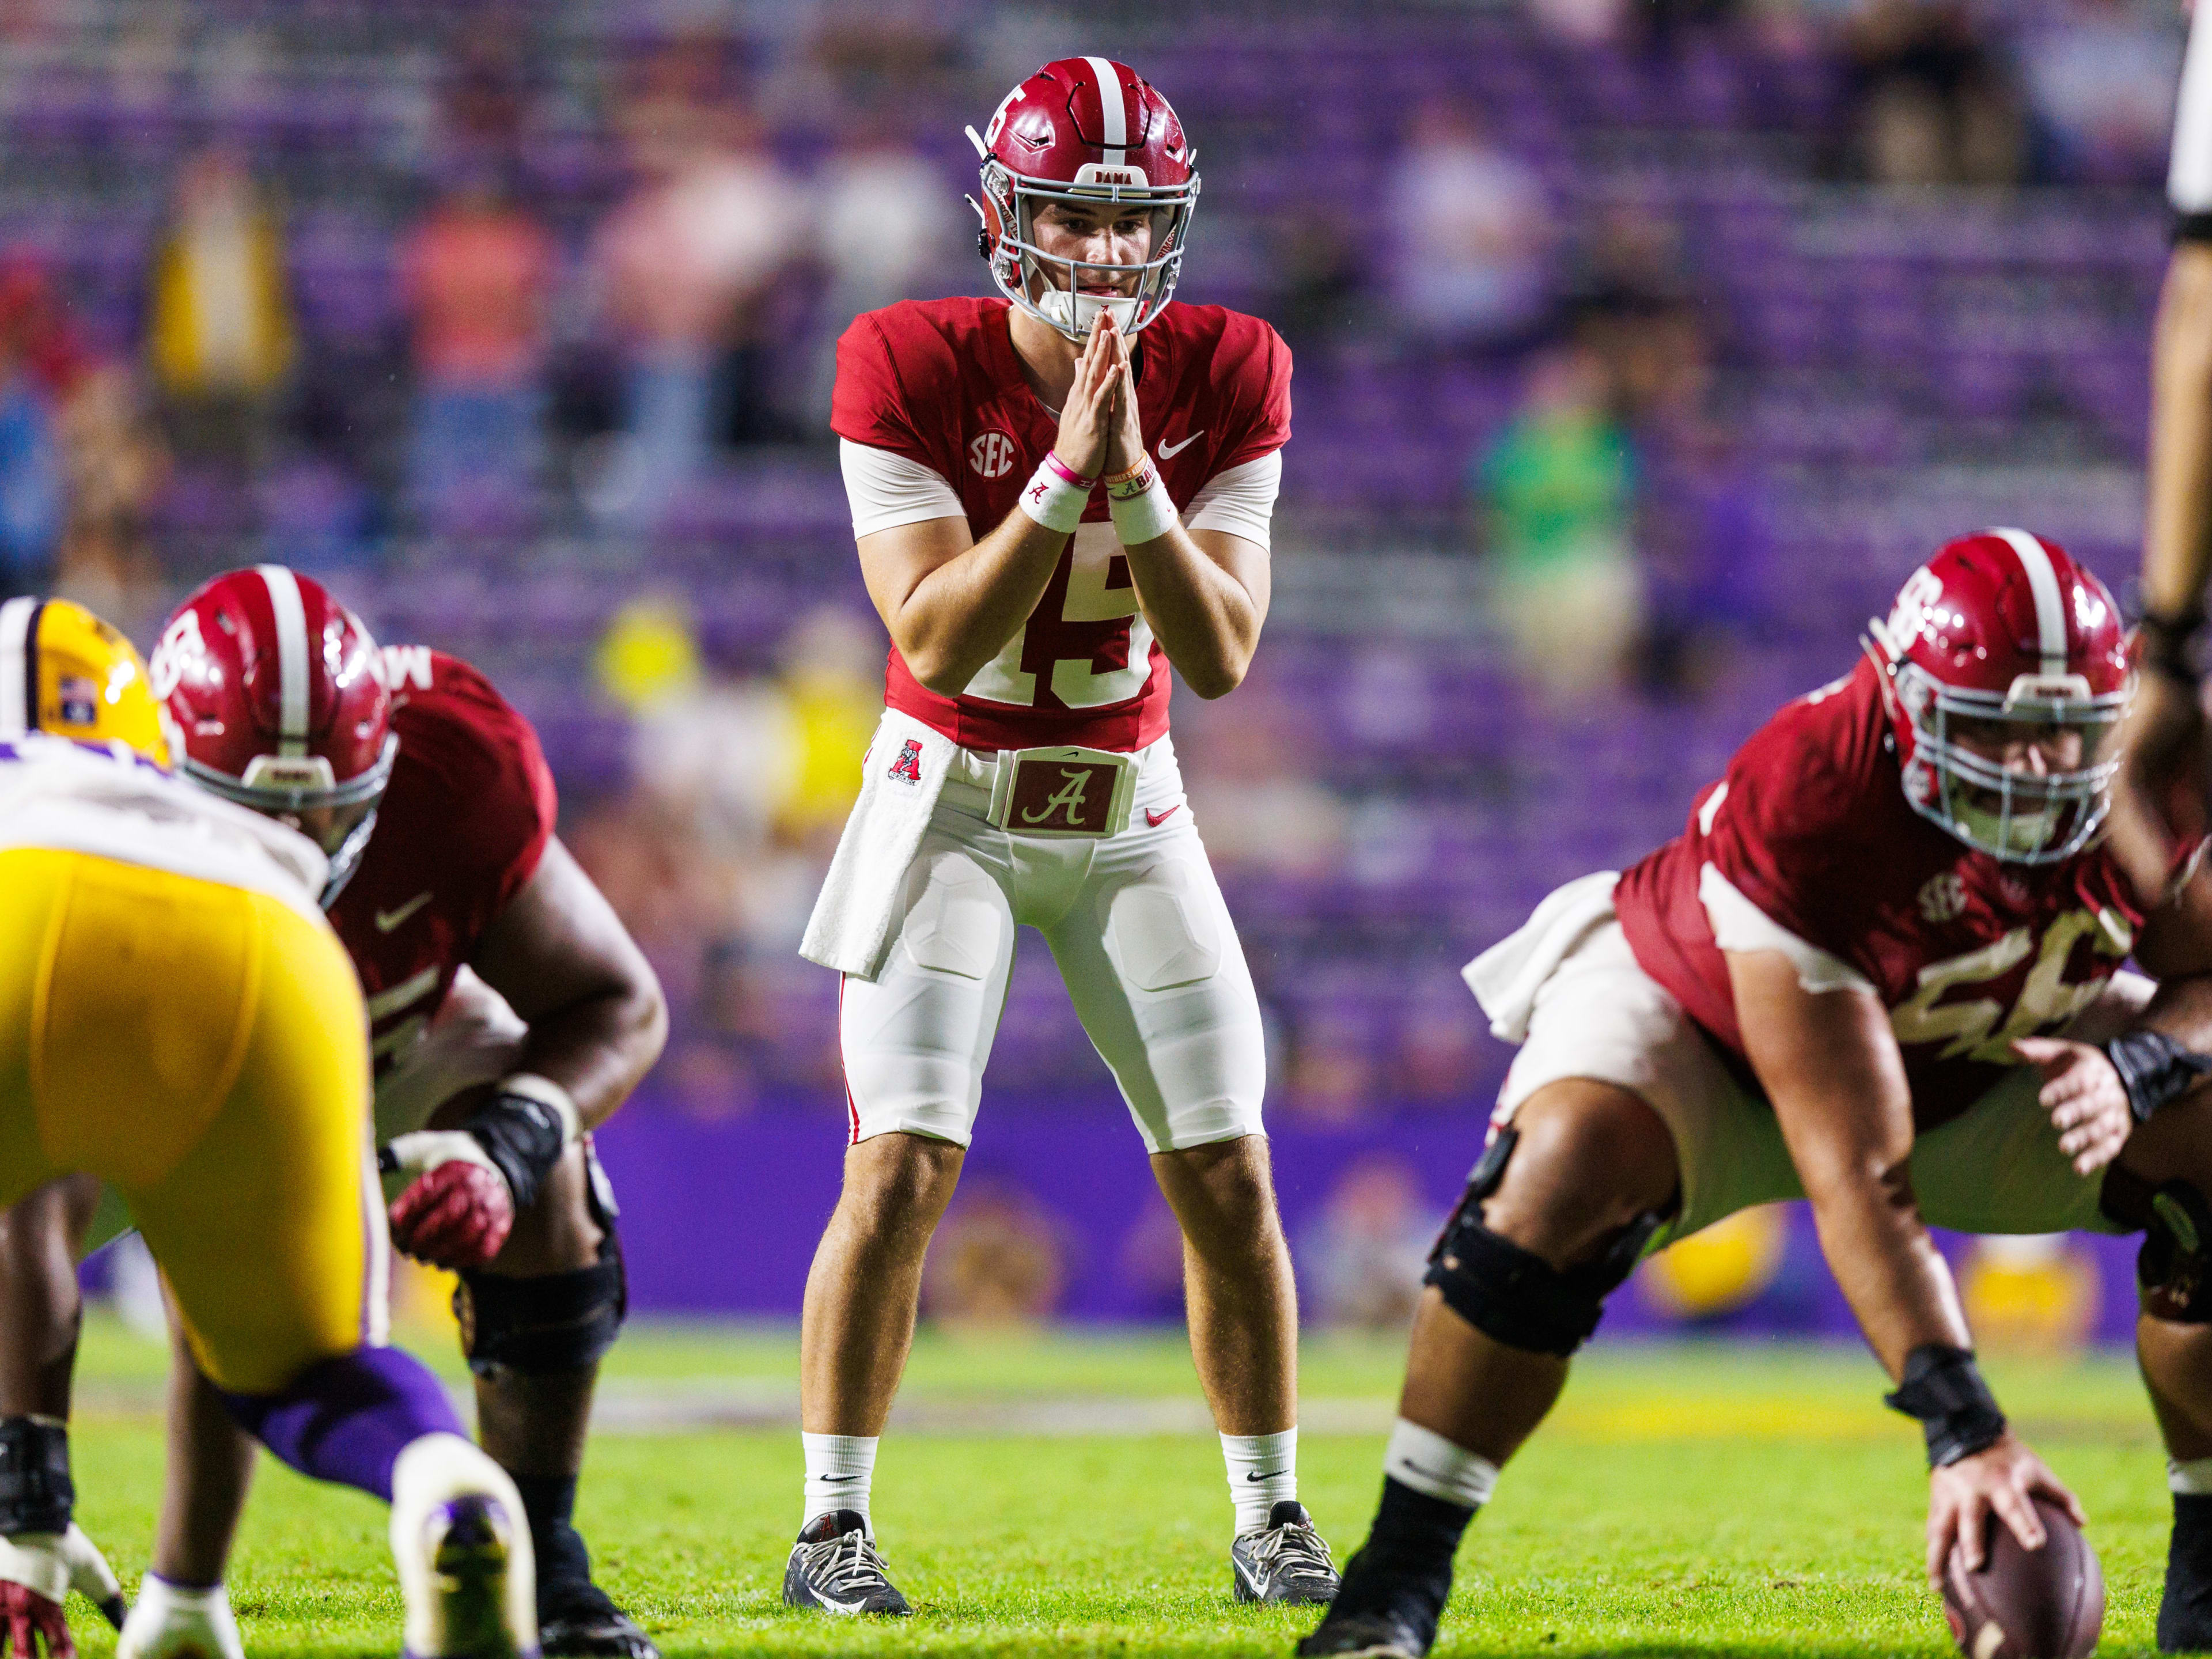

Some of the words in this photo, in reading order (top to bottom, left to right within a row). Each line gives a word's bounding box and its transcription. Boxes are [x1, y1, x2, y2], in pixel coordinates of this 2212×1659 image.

[1095, 171, 1132, 185] BAMA
[969, 433, 1014, 478] SEC
[1021, 767, 1093, 825] A
